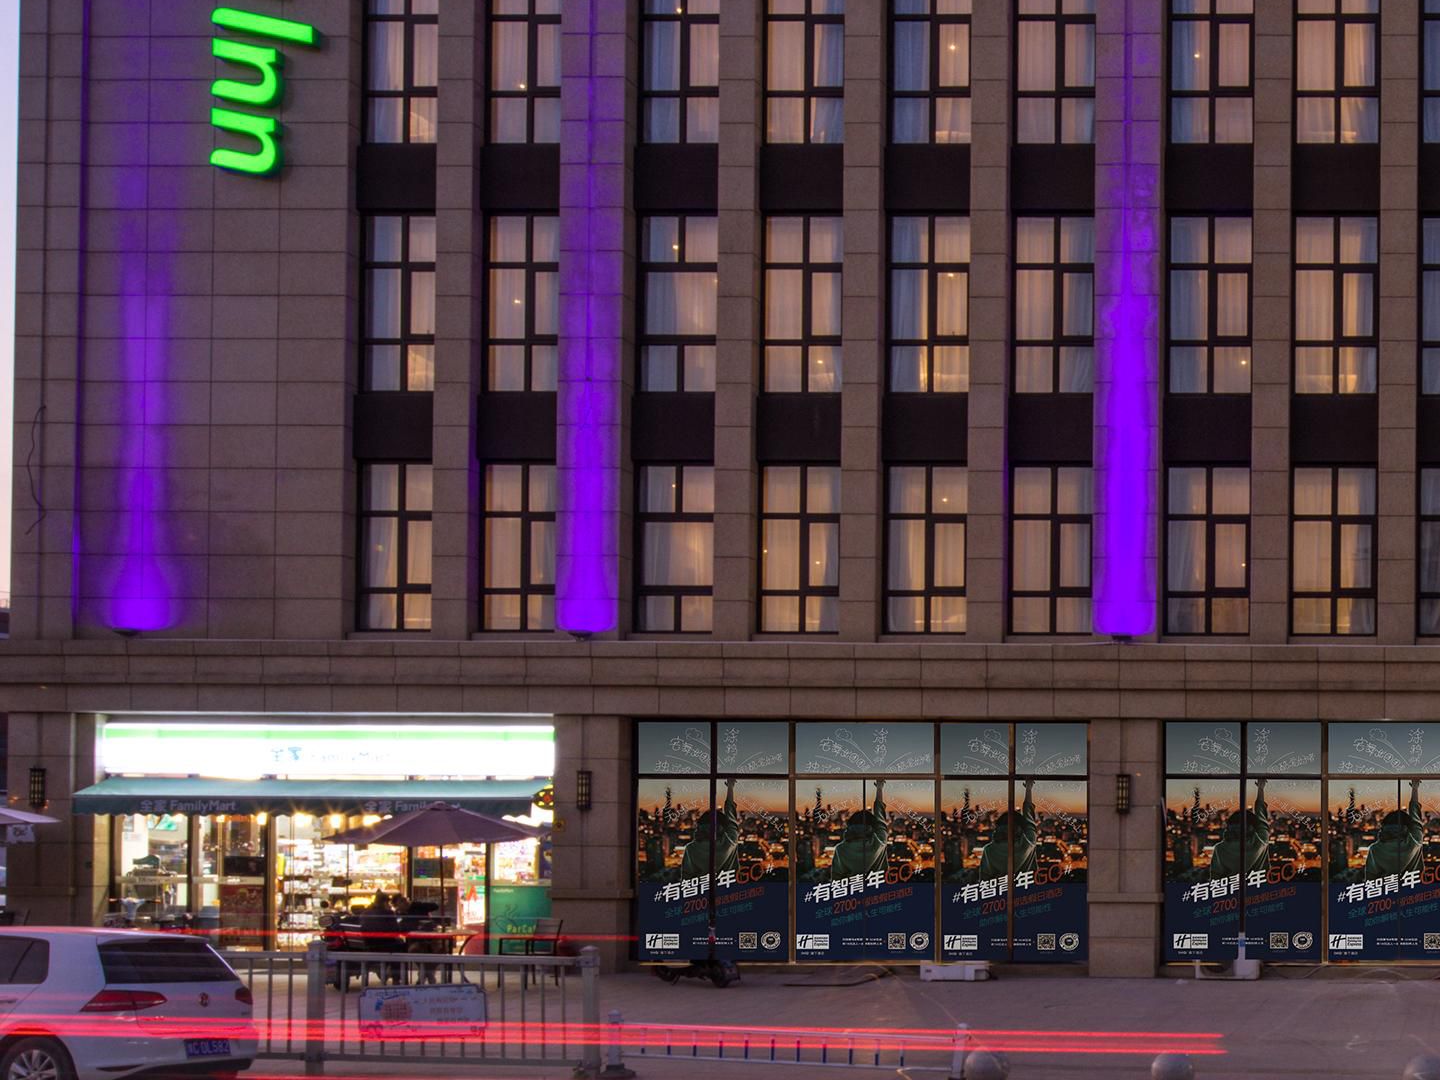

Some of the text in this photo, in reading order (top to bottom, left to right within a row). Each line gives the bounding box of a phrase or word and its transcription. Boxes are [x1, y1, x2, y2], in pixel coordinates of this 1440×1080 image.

[210, 7, 314, 174] Inn
[141, 800, 236, 814] 全家 FamilyMart
